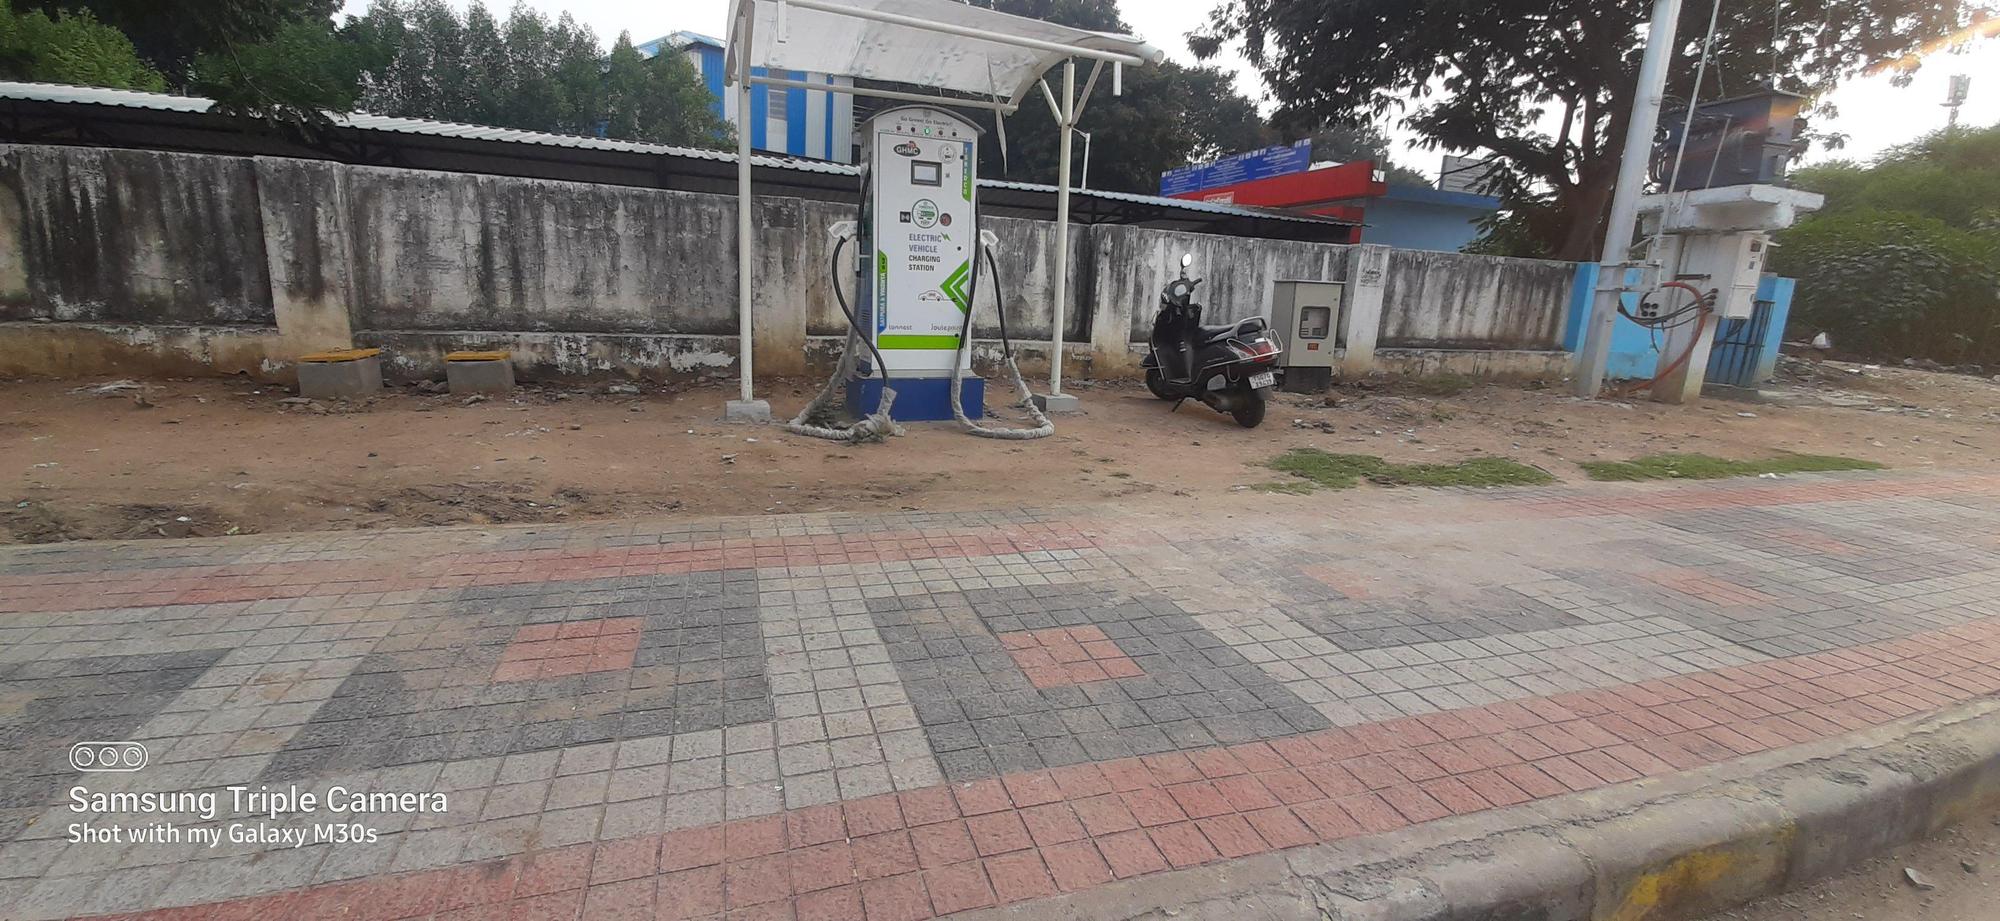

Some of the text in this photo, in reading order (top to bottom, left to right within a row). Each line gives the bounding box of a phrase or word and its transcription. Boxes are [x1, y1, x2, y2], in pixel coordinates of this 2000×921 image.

[896, 144, 919, 155] GHMC
[909, 233, 942, 243] ELECTRIC
[908, 243, 938, 253] VEHICLE
[908, 254, 941, 263] CHARGING
[908, 263, 935, 272] STATION
